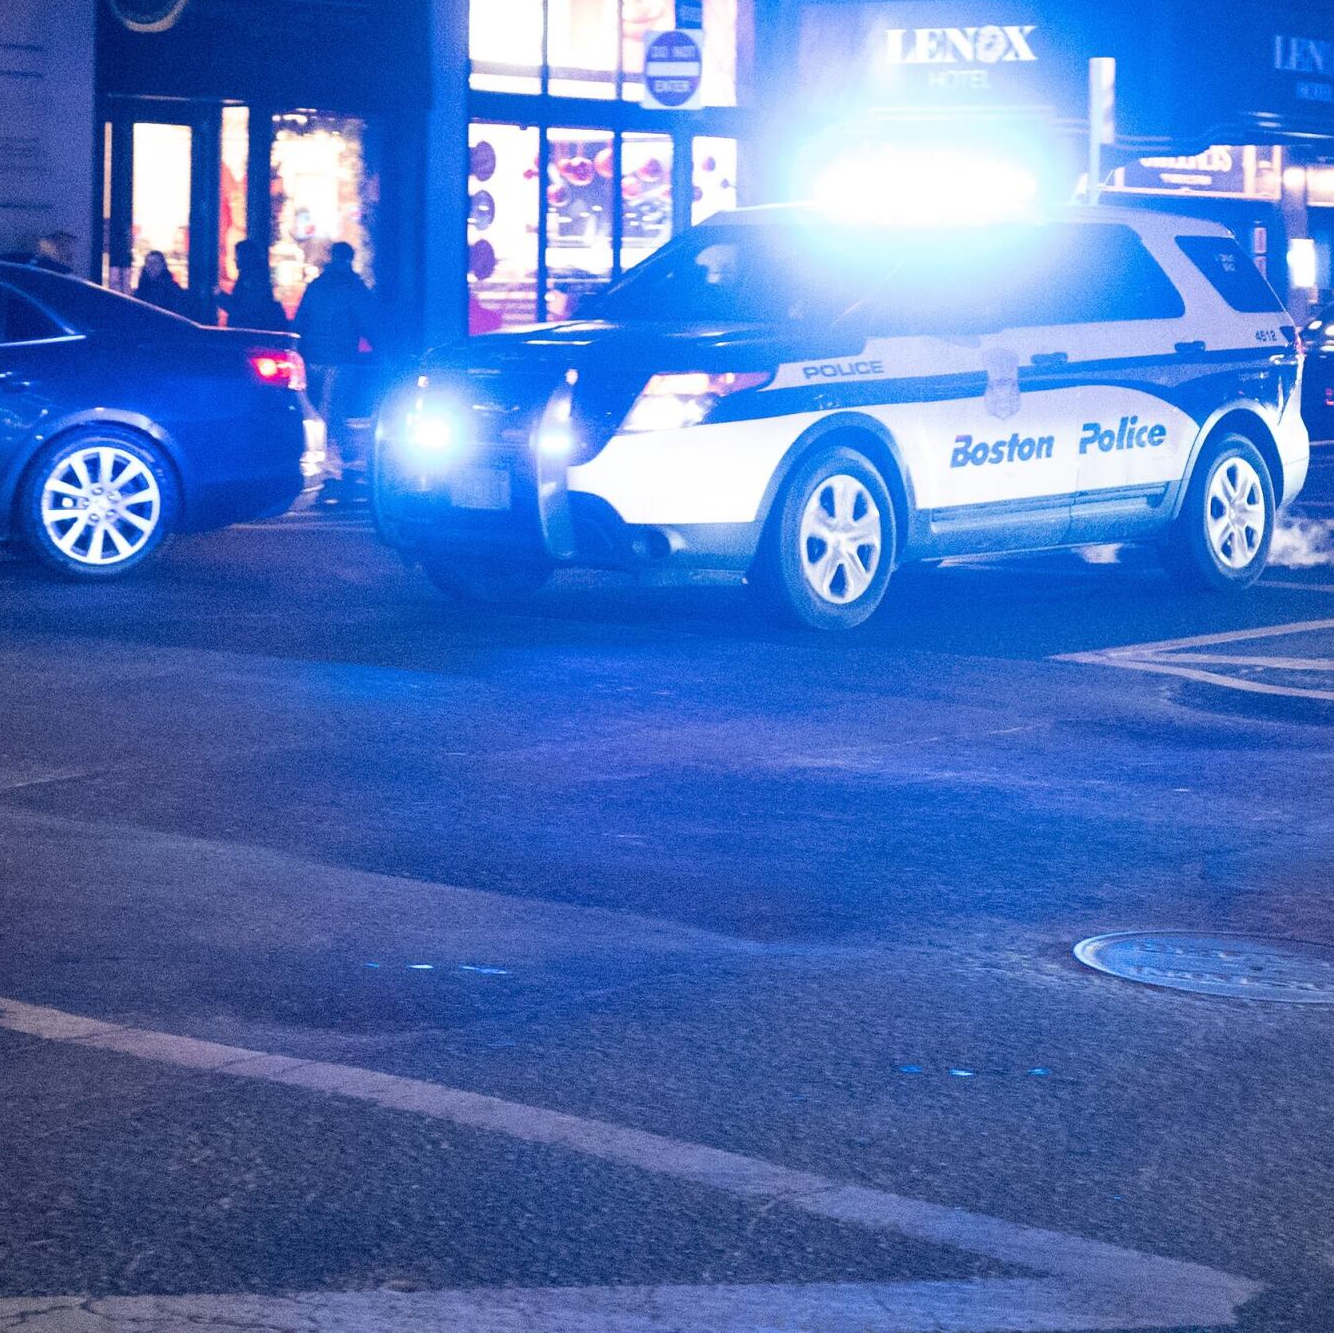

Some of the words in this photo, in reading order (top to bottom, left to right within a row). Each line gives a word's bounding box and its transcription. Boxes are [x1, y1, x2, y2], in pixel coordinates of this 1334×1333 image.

[884, 25, 1039, 64] LENOX
[654, 80, 690, 93] ENTER
[928, 69, 992, 90] HOTEL
[803, 360, 885, 380] POLICE
[951, 433, 1055, 468] Boston
[1079, 415, 1167, 455] Police
